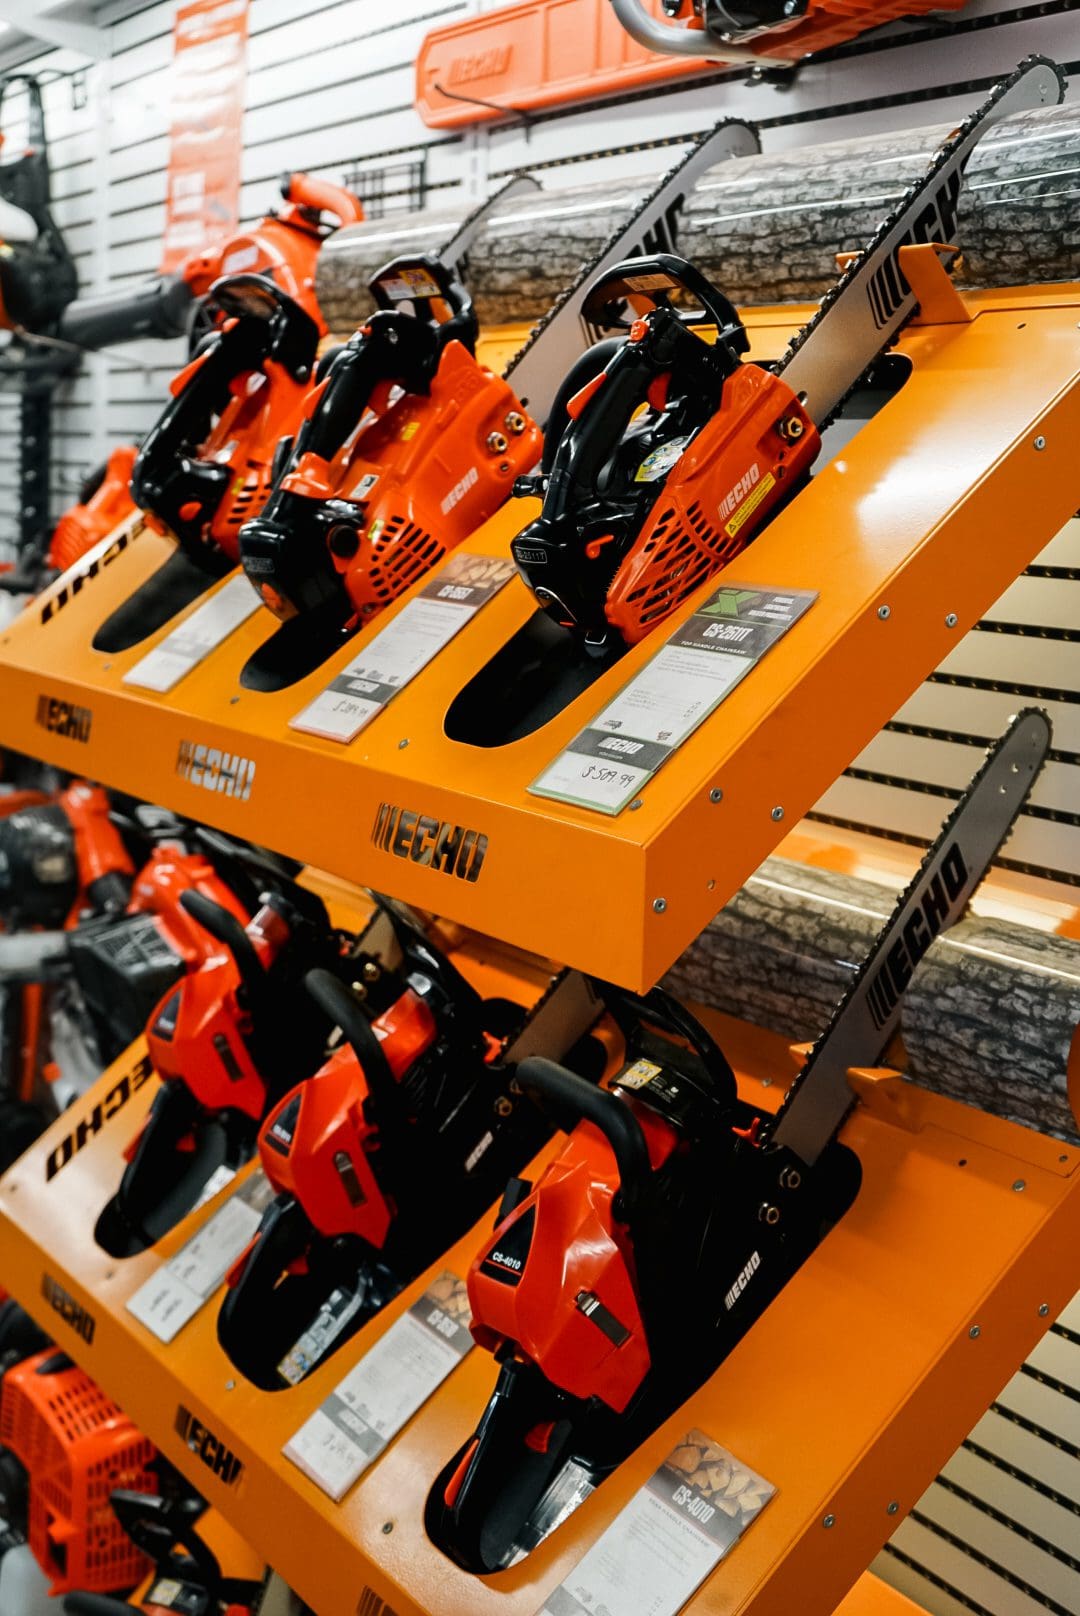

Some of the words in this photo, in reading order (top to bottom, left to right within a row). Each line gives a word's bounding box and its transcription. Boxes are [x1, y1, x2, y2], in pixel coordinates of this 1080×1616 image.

[445, 467, 479, 512] ECHO
[723, 463, 760, 515] ECHO
[693, 642, 715, 650] HANDLE
[715, 645, 747, 654] CHAINSAW
[702, 623, 755, 642] CS-2511T
[44, 696, 94, 744] ECHO
[603, 737, 646, 754] ECHO
[184, 743, 257, 803] ECHO
[388, 806, 489, 883] ECHO
[878, 843, 968, 1006] ECHO
[492, 1252, 521, 1270] CS-4010
[729, 1250, 761, 1305] ECHO
[672, 1485, 715, 1524] CS-4010
